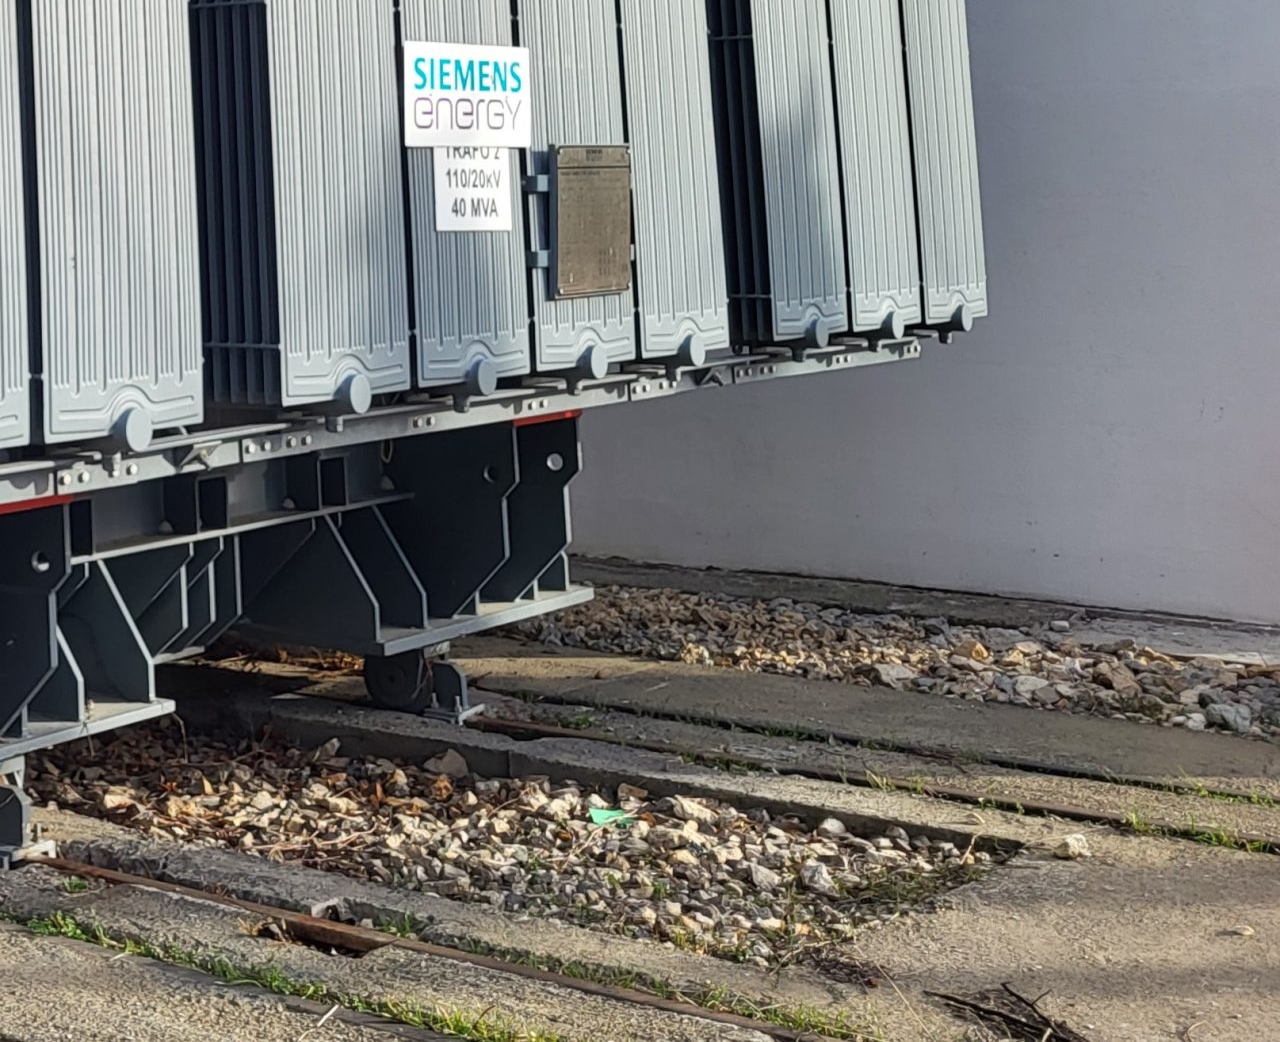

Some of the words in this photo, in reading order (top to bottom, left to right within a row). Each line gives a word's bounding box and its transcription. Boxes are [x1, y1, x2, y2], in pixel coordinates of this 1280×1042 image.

[414, 57, 522, 93] SIEMENS
[451, 197, 467, 218] 40
[471, 197, 499, 218] MVA
